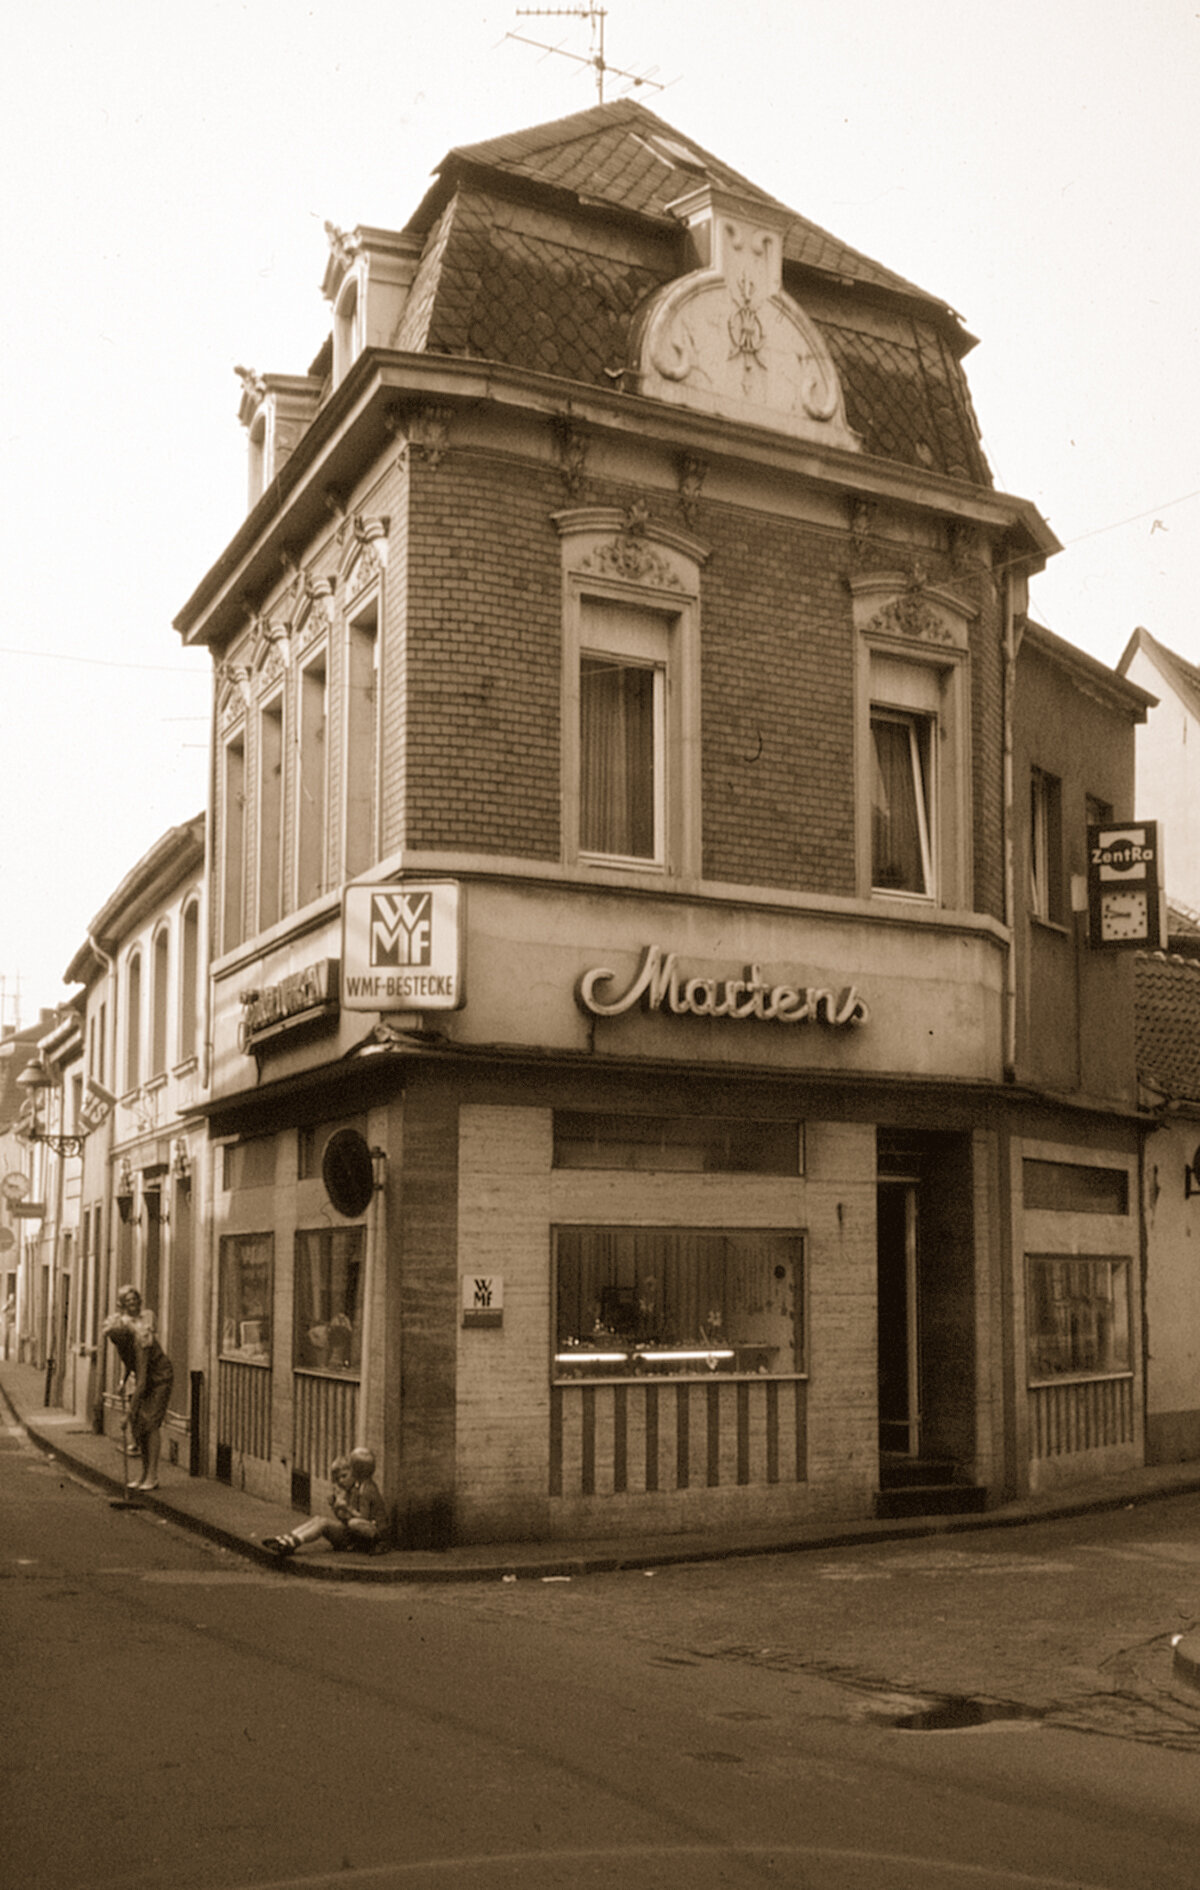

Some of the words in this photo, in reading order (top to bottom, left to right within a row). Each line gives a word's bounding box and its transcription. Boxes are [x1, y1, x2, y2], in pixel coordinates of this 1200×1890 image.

[1092, 846, 1154, 864] ZentRa
[346, 976, 453, 997] WMF-BESTECKE
[581, 944, 870, 1025] Martens
